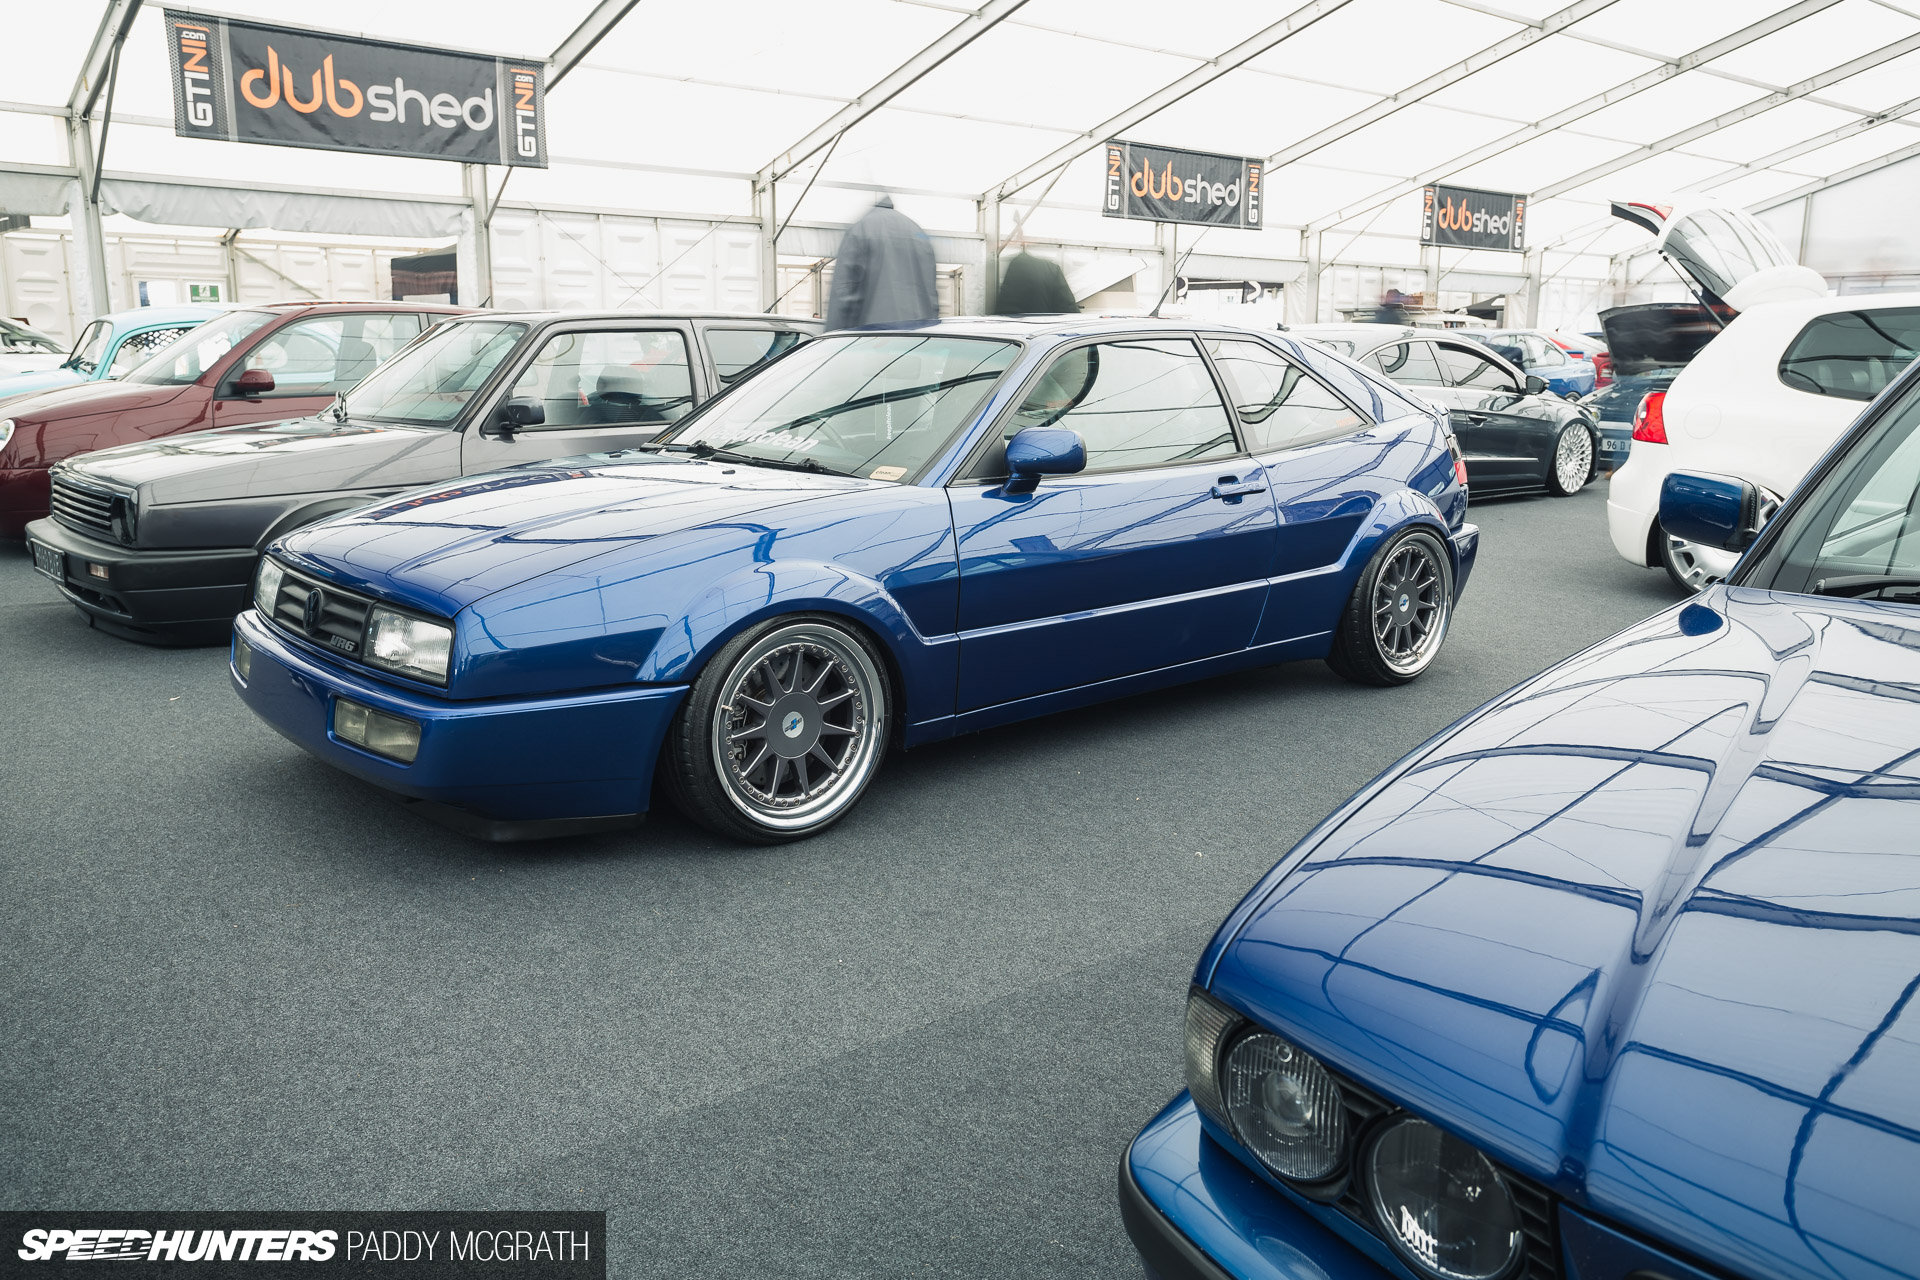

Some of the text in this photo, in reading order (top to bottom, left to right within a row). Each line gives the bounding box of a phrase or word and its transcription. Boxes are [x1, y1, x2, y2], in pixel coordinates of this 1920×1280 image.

[1606, 440, 1616, 449] 96
[1620, 441, 1625, 450] D
[331, 634, 355, 651] VR6
